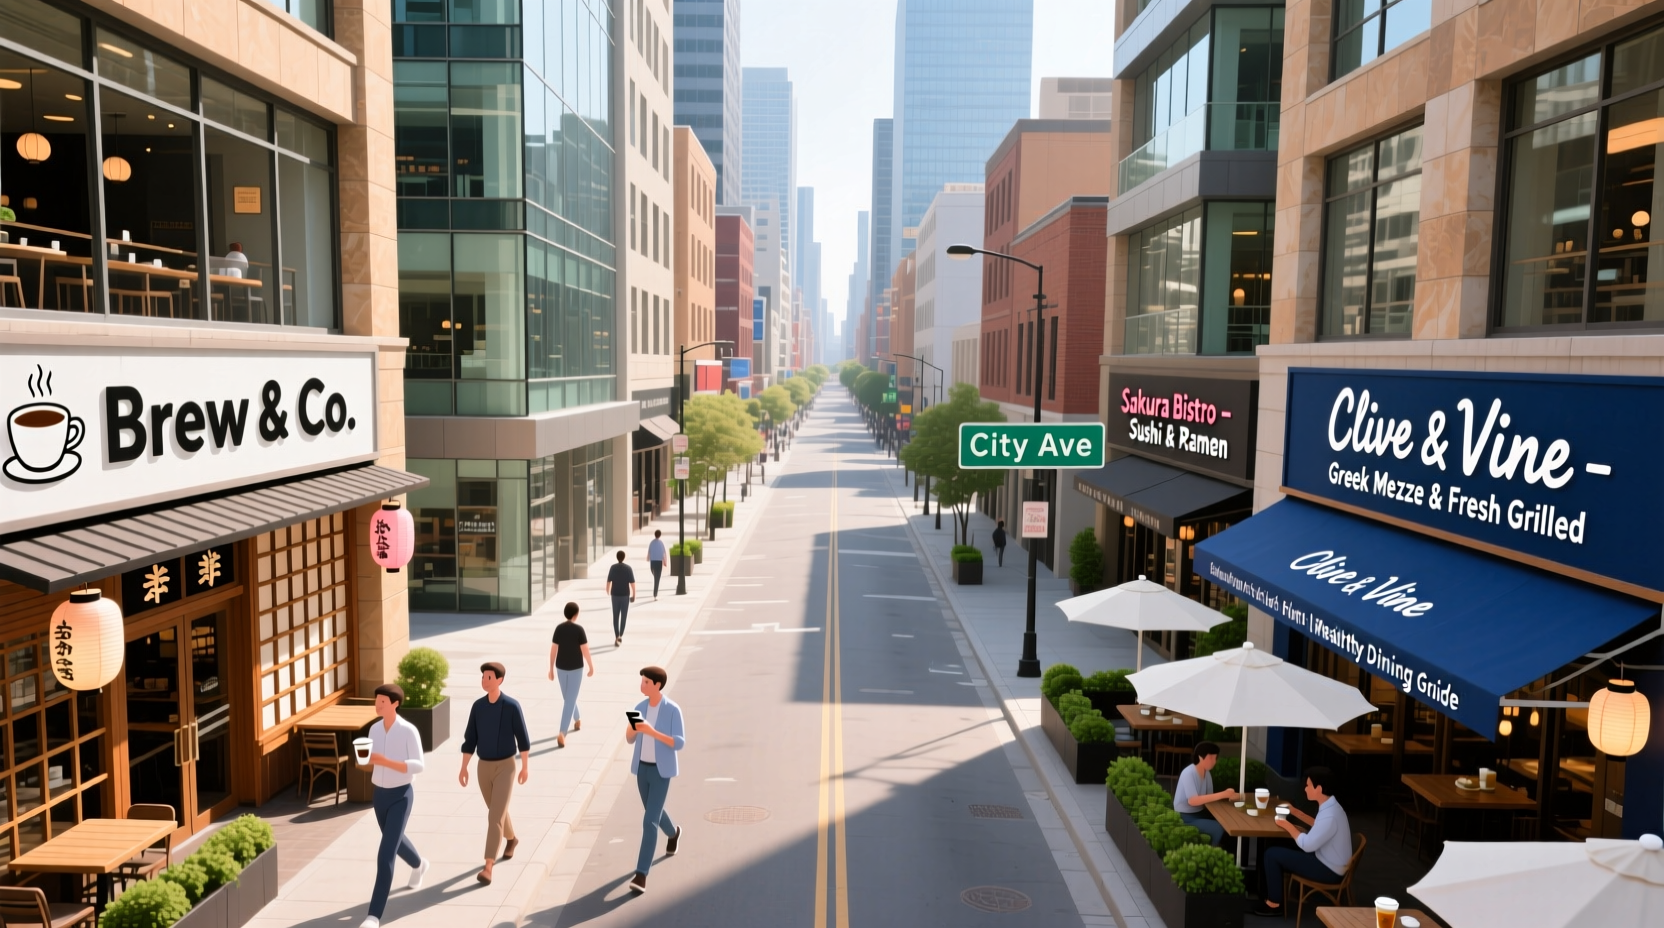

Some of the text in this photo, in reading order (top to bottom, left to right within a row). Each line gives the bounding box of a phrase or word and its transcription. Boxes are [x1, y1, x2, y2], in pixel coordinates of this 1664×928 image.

[105, 377, 356, 463] Brew & Co.
[1121, 387, 1170, 419] Sakura
[1173, 393, 1217, 425] Bistro
[970, 432, 1092, 463] City Ave
[1129, 418, 1228, 460] Sushi & Ramen
[1328, 387, 1414, 460] Clive
[1420, 410, 1449, 471] &
[1457, 398, 1574, 489] Vine
[1328, 461, 1586, 544] Greek Mezze & Fresh Grilled
[1341, 576, 1376, 596] &
[1361, 576, 1434, 617] Vine
[1367, 643, 1414, 693] Dining
